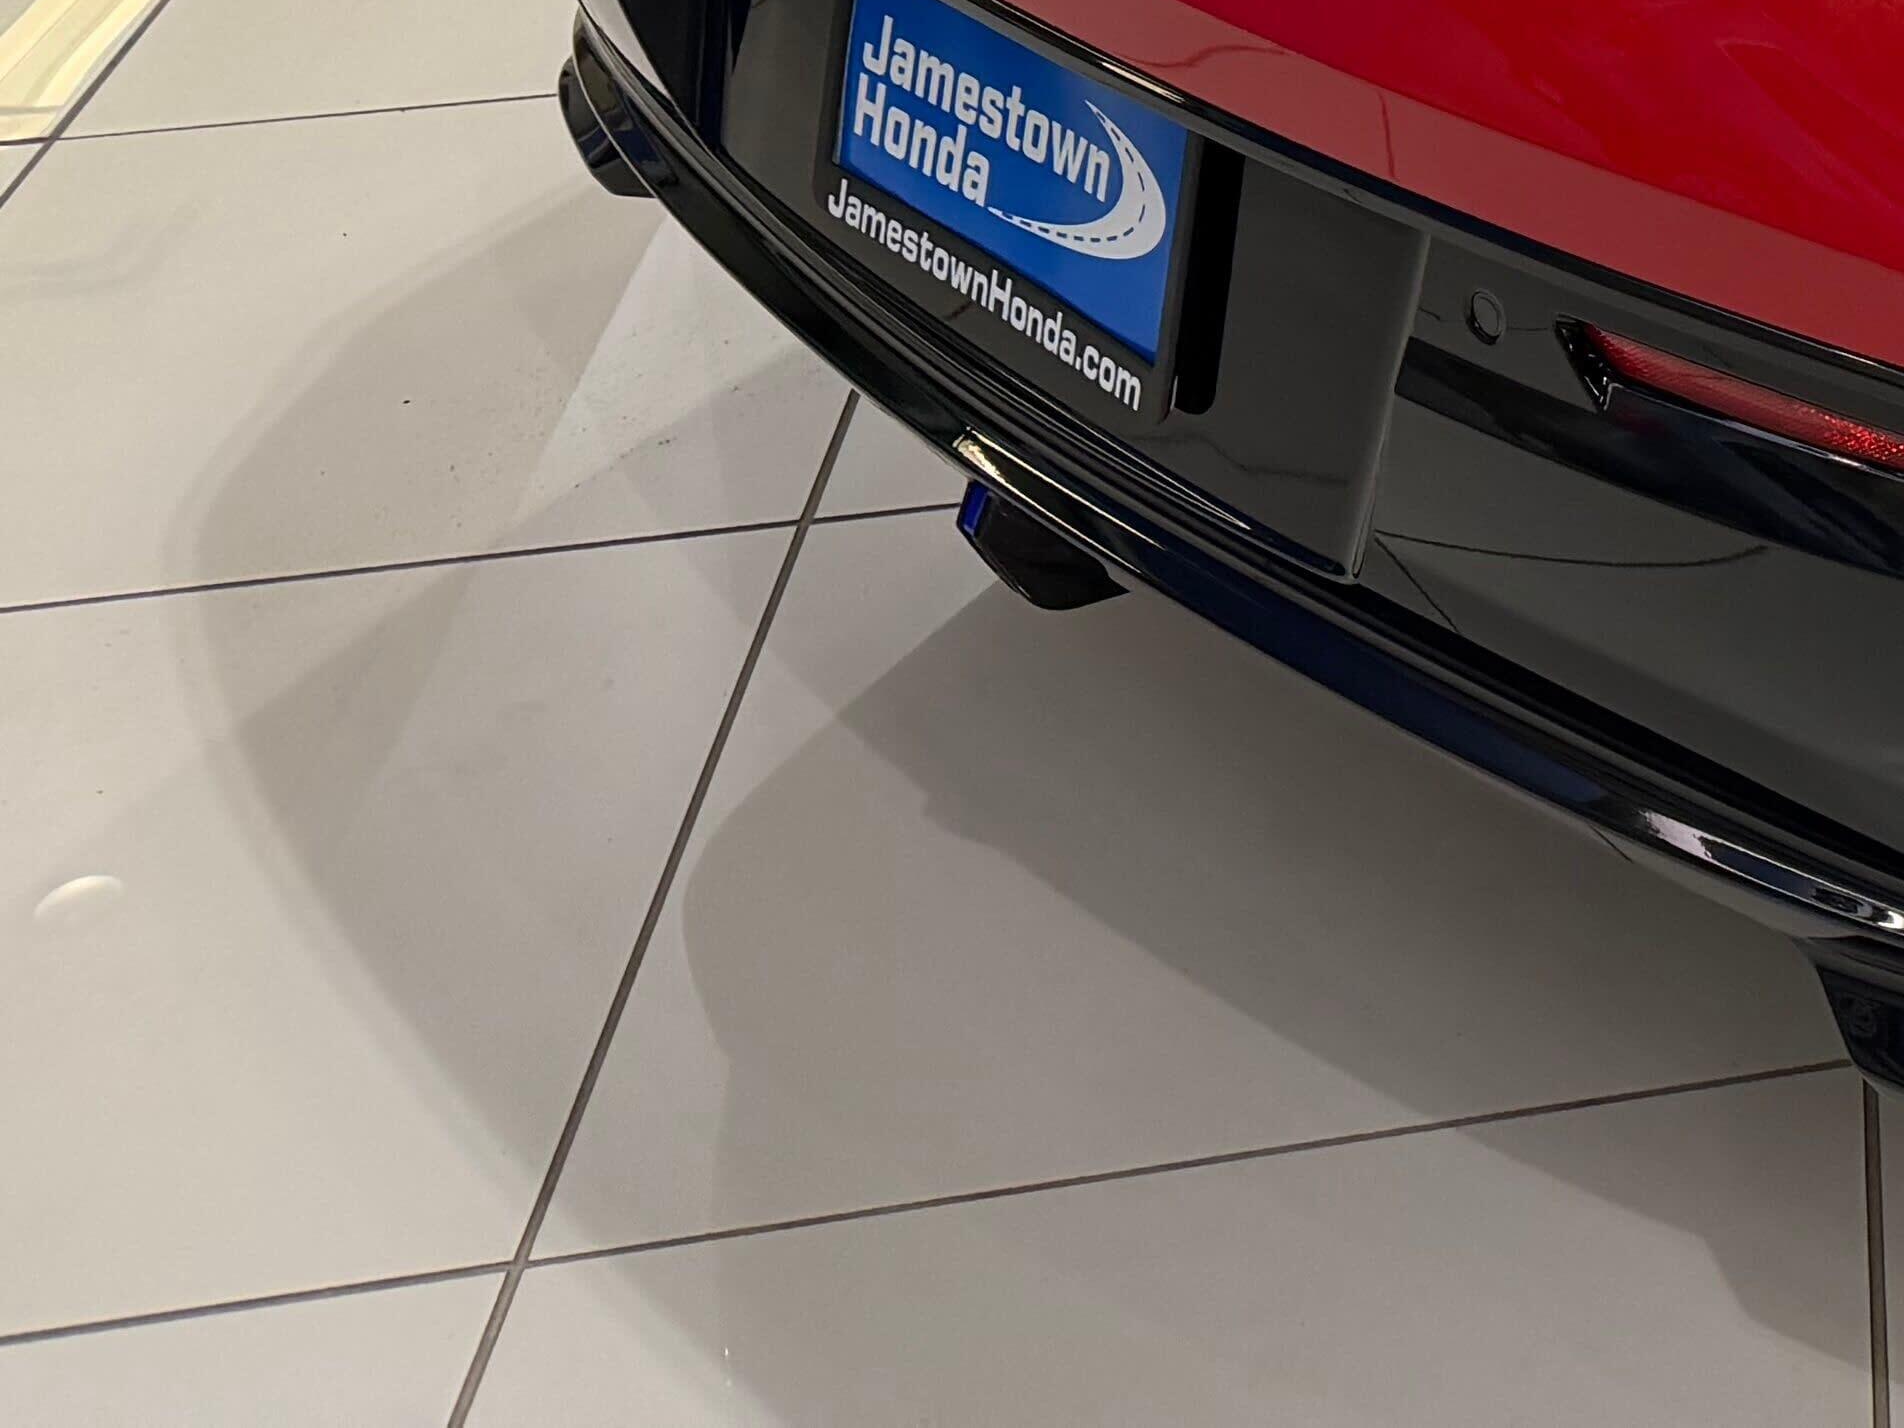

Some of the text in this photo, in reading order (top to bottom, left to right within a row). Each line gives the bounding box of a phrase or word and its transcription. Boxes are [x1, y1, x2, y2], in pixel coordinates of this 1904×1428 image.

[853, 72, 990, 208] Honda
[862, 14, 1111, 203] Jamestown
[827, 178, 1142, 412] JamestownHonda.com
